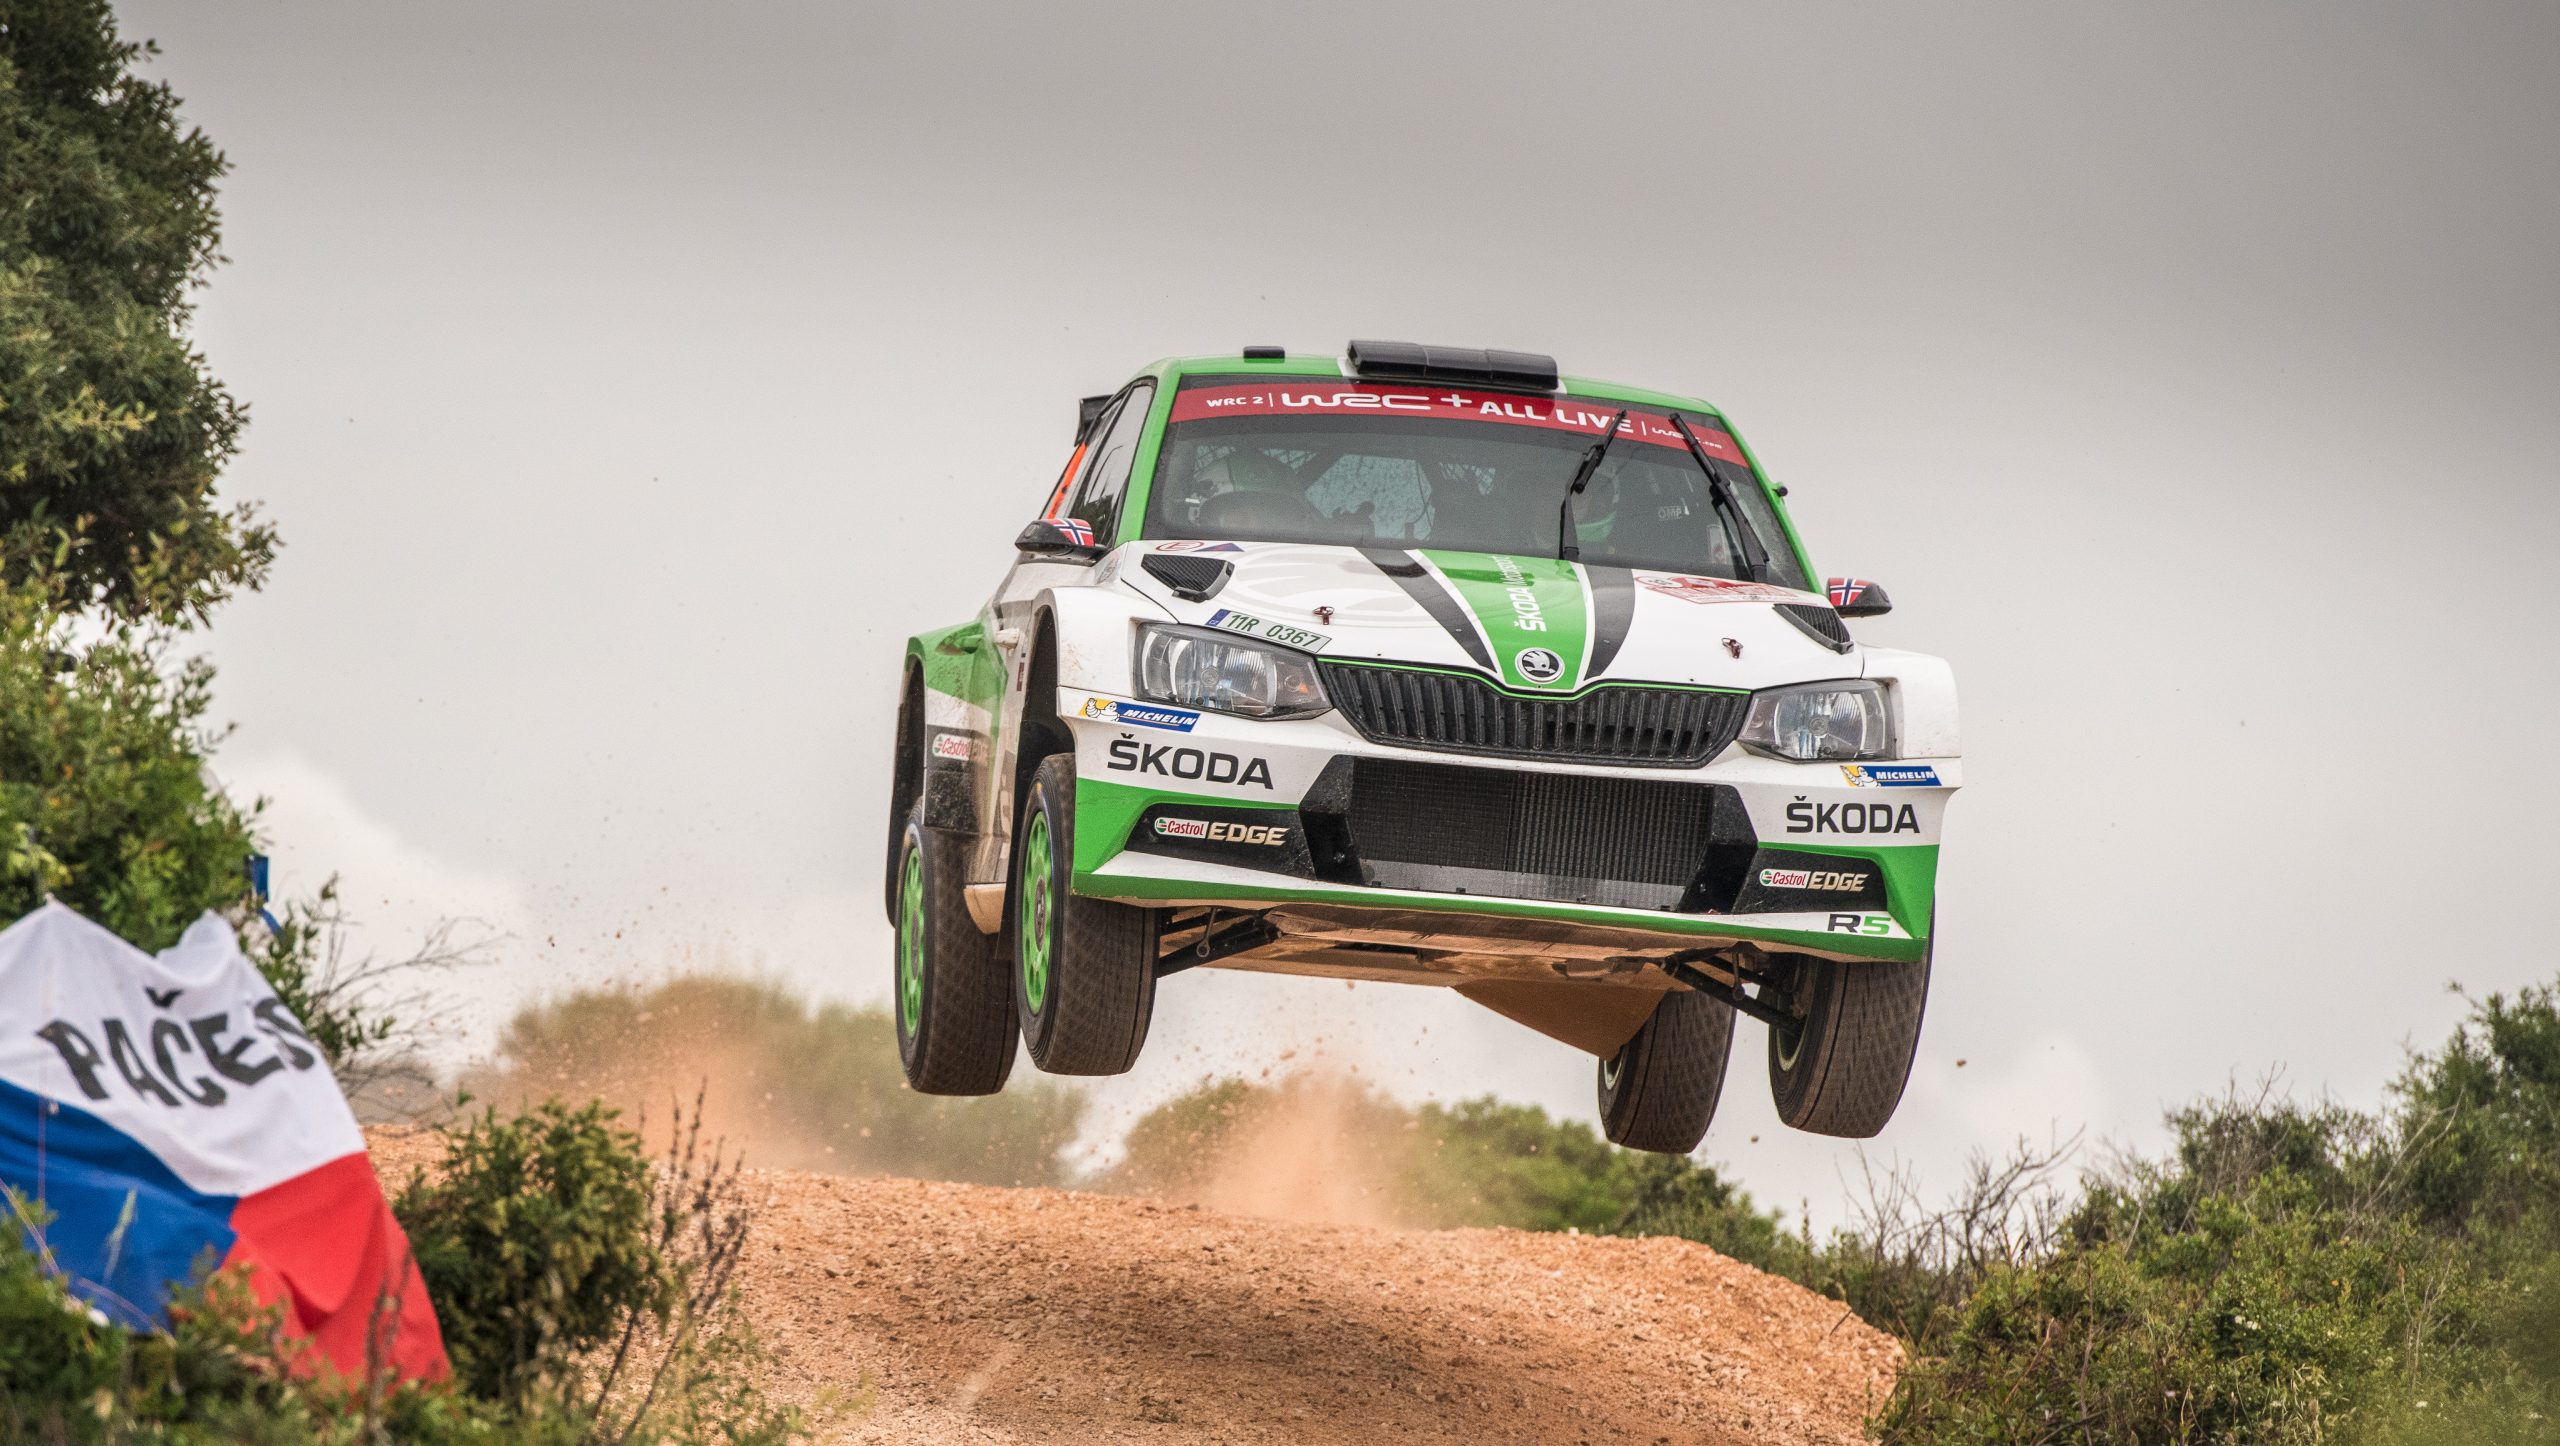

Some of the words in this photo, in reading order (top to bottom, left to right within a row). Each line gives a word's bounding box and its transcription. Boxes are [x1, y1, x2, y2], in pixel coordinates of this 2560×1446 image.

[1207, 396, 1247, 407] WRC
[1253, 396, 1264, 405] 2
[1281, 392, 1431, 410] WRC
[1479, 401, 1547, 421] ALL
[1555, 408, 1634, 434] LIVE
[1506, 587, 1547, 632] ŠKODA
[1227, 614, 1260, 632] 11R
[1266, 624, 1321, 647] 0367
[1122, 708, 1197, 726] MICHELIN
[1107, 732, 1274, 790] ŠKODA
[1875, 771, 1936, 779] MICHELIN
[1786, 795, 1921, 834] ŠKODA
[1167, 819, 1204, 836] Castrol
[1207, 822, 1291, 846] EDGE
[1772, 871, 1806, 886] Castrol
[1807, 871, 1870, 892] EDGE
[1827, 913, 1892, 935] R5
